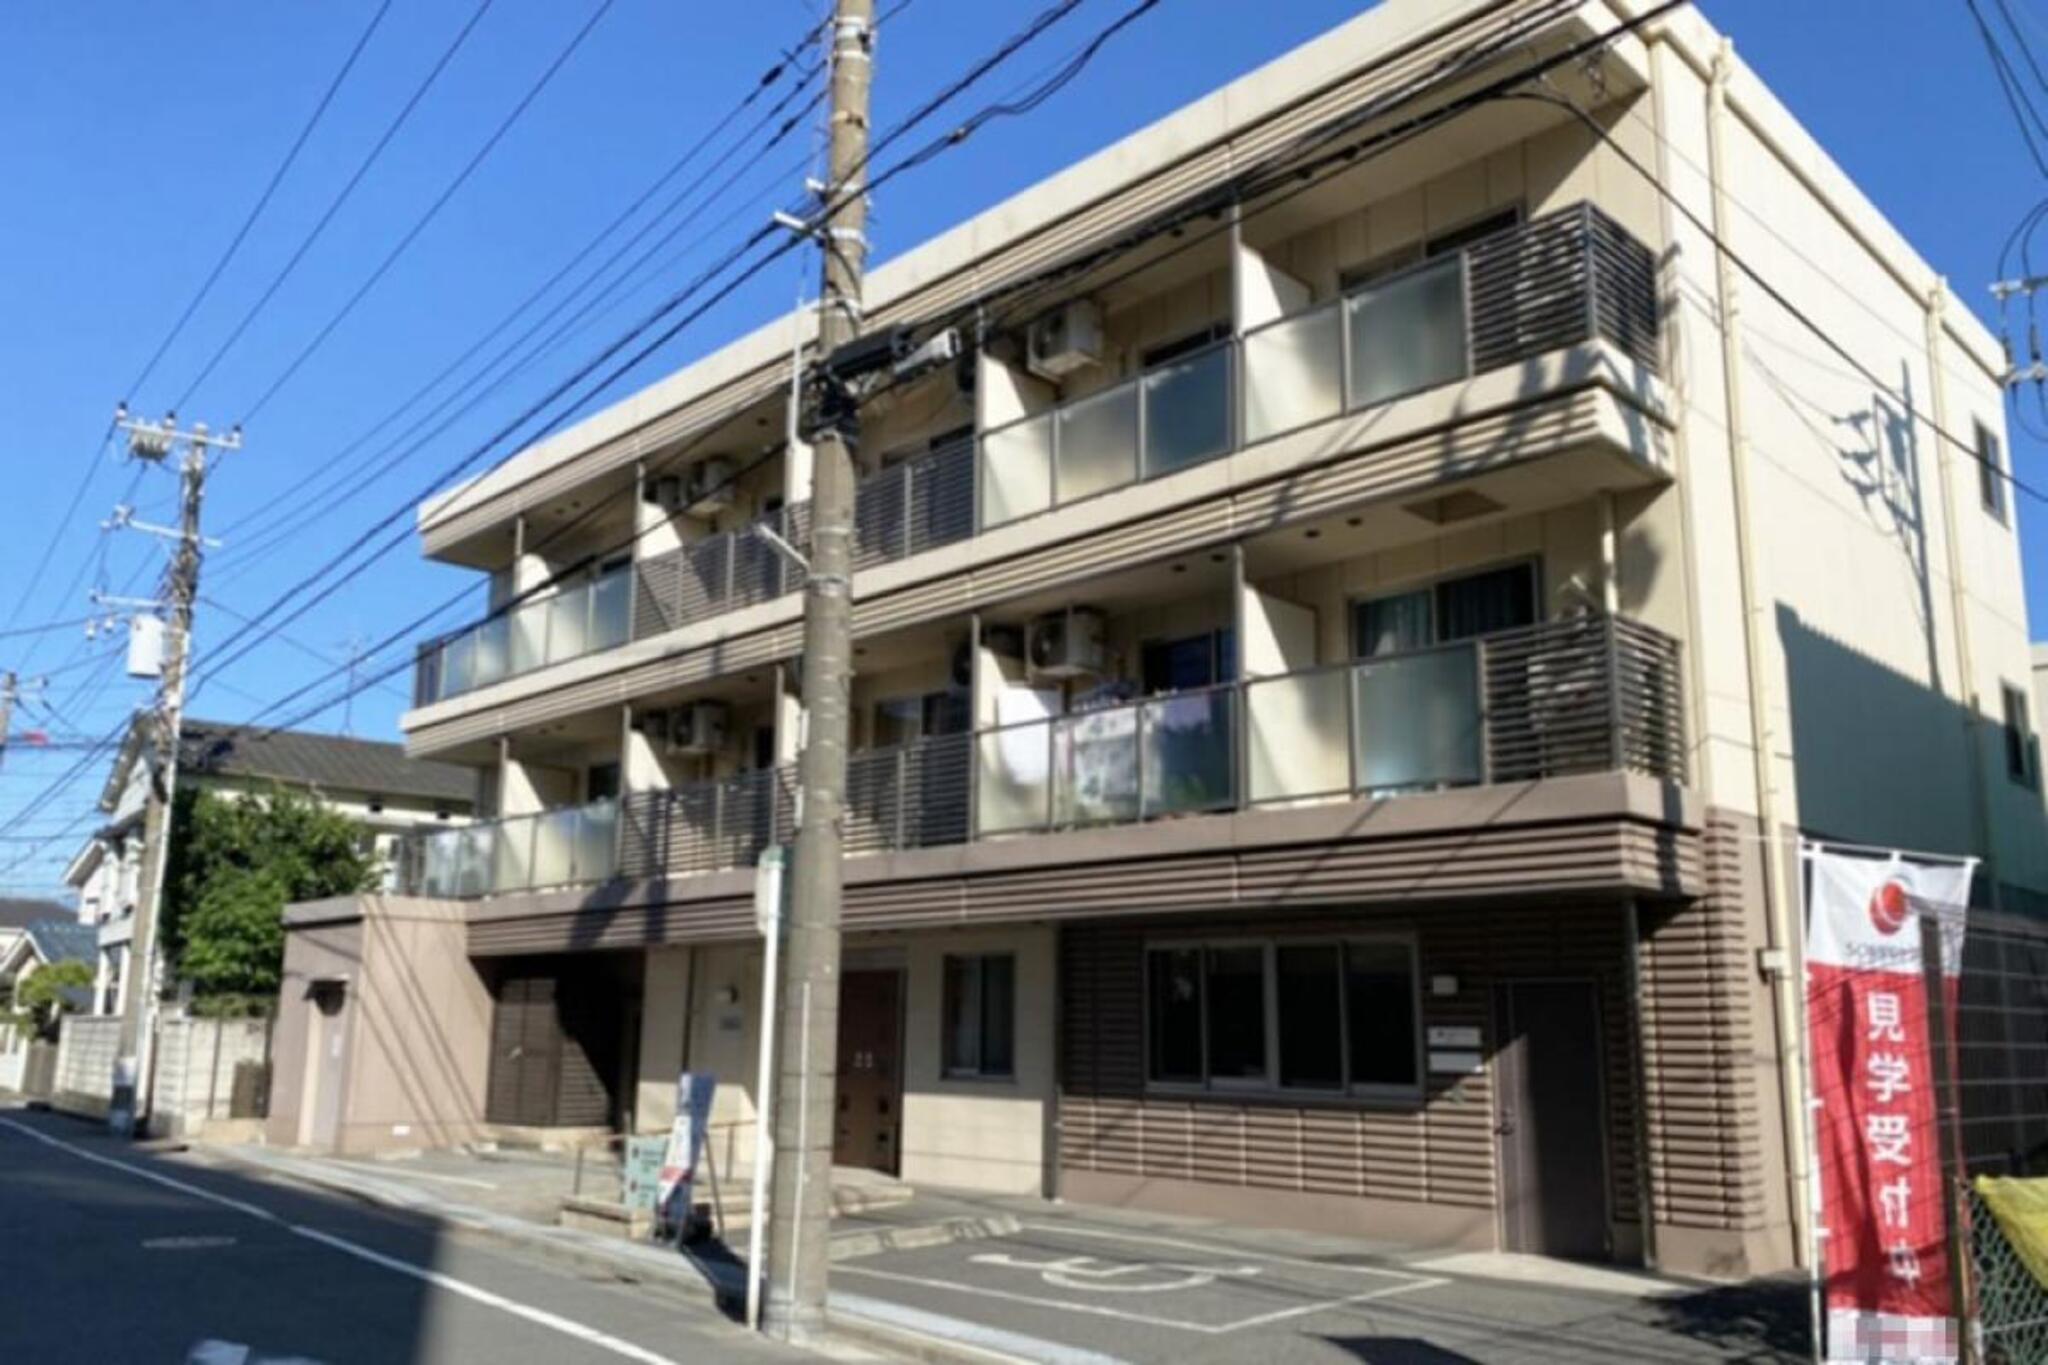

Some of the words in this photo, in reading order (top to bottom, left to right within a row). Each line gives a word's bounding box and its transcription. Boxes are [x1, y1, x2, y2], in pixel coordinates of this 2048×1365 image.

[1866, 990, 1922, 1289] 見学受付中
